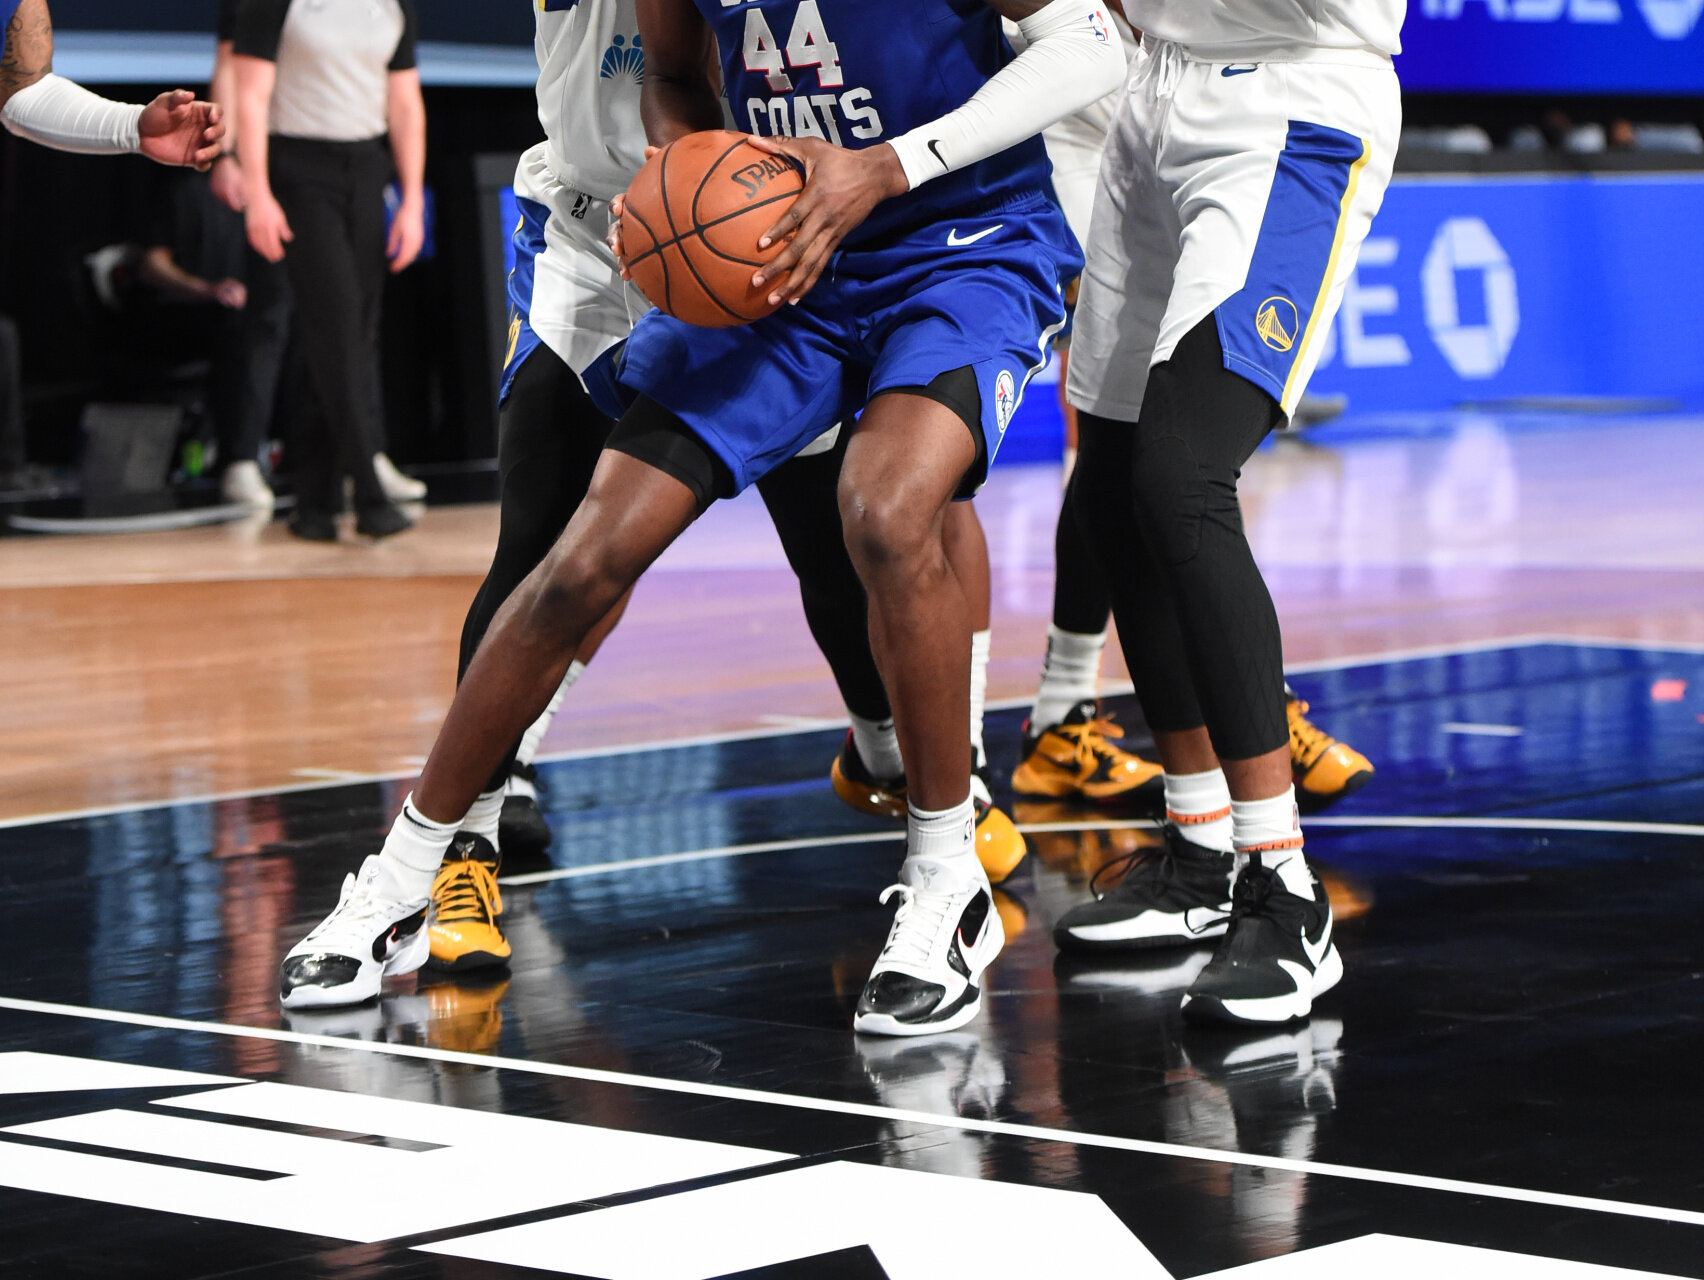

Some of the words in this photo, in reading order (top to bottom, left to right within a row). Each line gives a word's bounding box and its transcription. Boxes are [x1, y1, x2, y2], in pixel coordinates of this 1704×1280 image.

[742, 0, 843, 93] 44
[746, 86, 884, 148] COATS
[731, 156, 795, 201] SPAL
